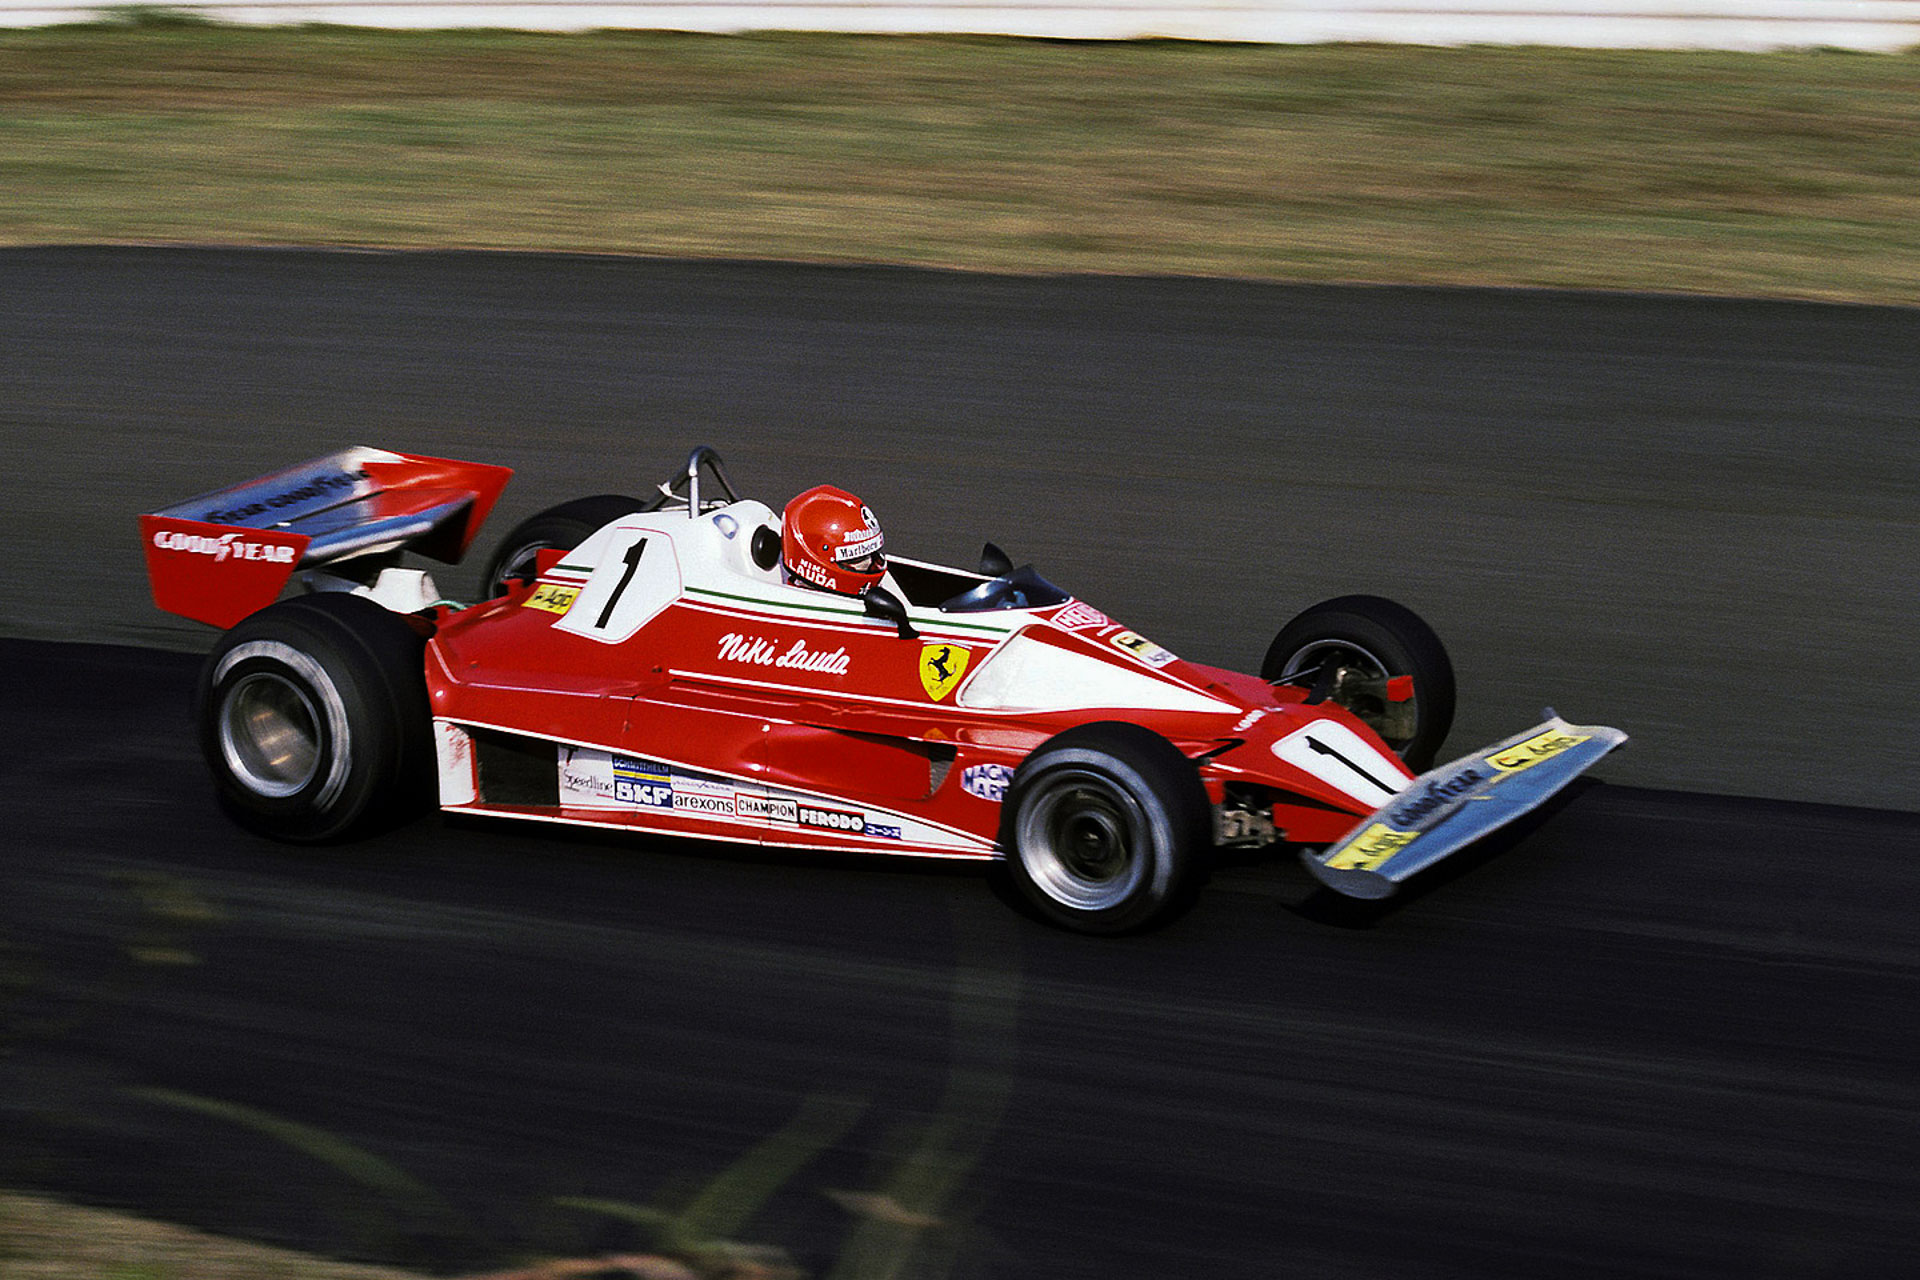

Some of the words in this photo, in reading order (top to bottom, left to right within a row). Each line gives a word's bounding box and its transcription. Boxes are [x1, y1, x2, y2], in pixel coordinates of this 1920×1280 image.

[788, 558, 837, 590] LAUDA
[800, 558, 826, 575] NIKI
[594, 538, 648, 629] 1
[717, 632, 778, 666] Niki
[775, 639, 850, 675] Lauda
[1304, 735, 1401, 795] 1
[563, 768, 613, 792] Speedline
[615, 781, 673, 806] SKF
[674, 795, 734, 813] arexons
[738, 799, 796, 817] CHAMPION
[799, 808, 864, 832] FERODO
